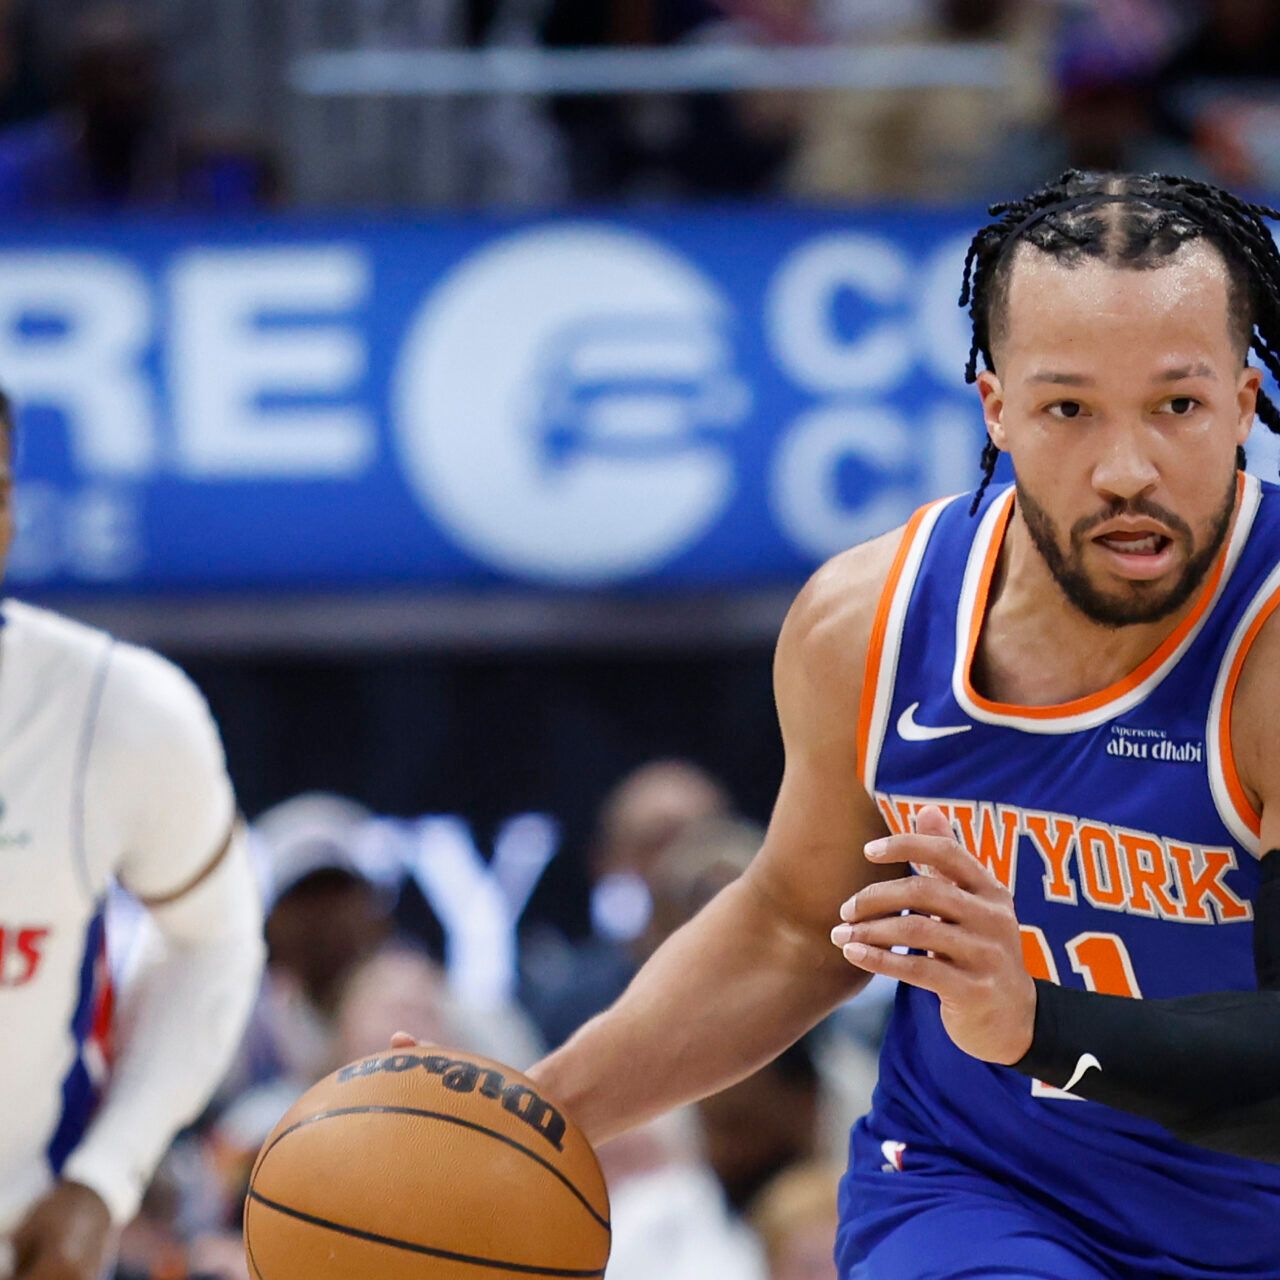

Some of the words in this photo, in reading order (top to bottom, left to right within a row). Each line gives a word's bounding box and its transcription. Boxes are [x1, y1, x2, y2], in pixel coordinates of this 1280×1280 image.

[1107, 737, 1148, 758] abu
[1151, 740, 1202, 762] dhabi
[874, 794, 1018, 897] NW
[1016, 808, 1254, 926] YORK
